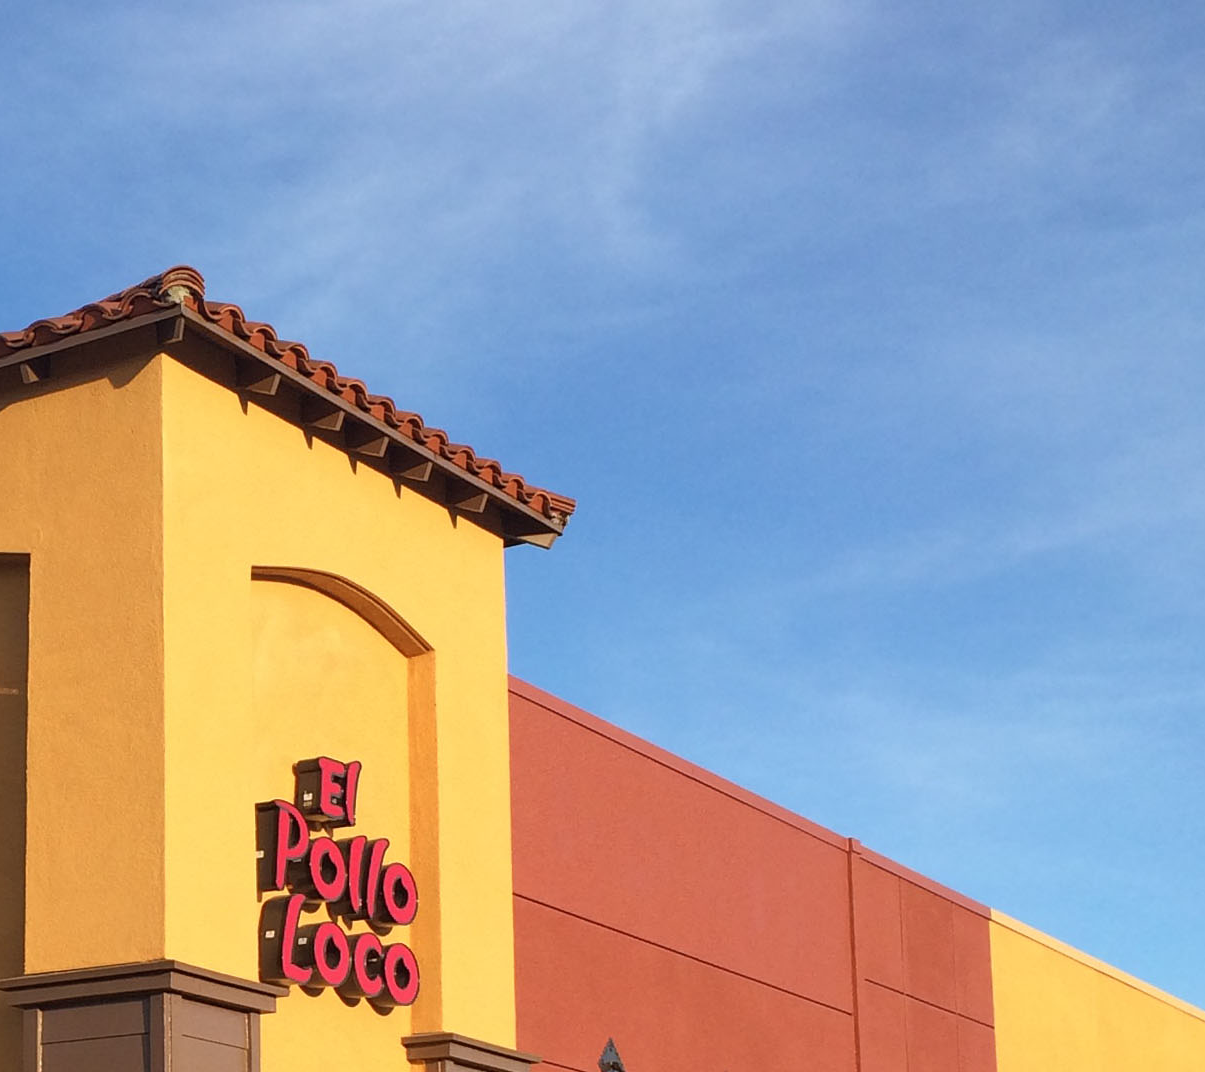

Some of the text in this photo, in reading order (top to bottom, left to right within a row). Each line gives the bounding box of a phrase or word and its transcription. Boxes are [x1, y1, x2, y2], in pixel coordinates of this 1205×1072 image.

[317, 756, 363, 827] El
[273, 798, 419, 926] Pollo
[281, 893, 420, 1007] Loco
